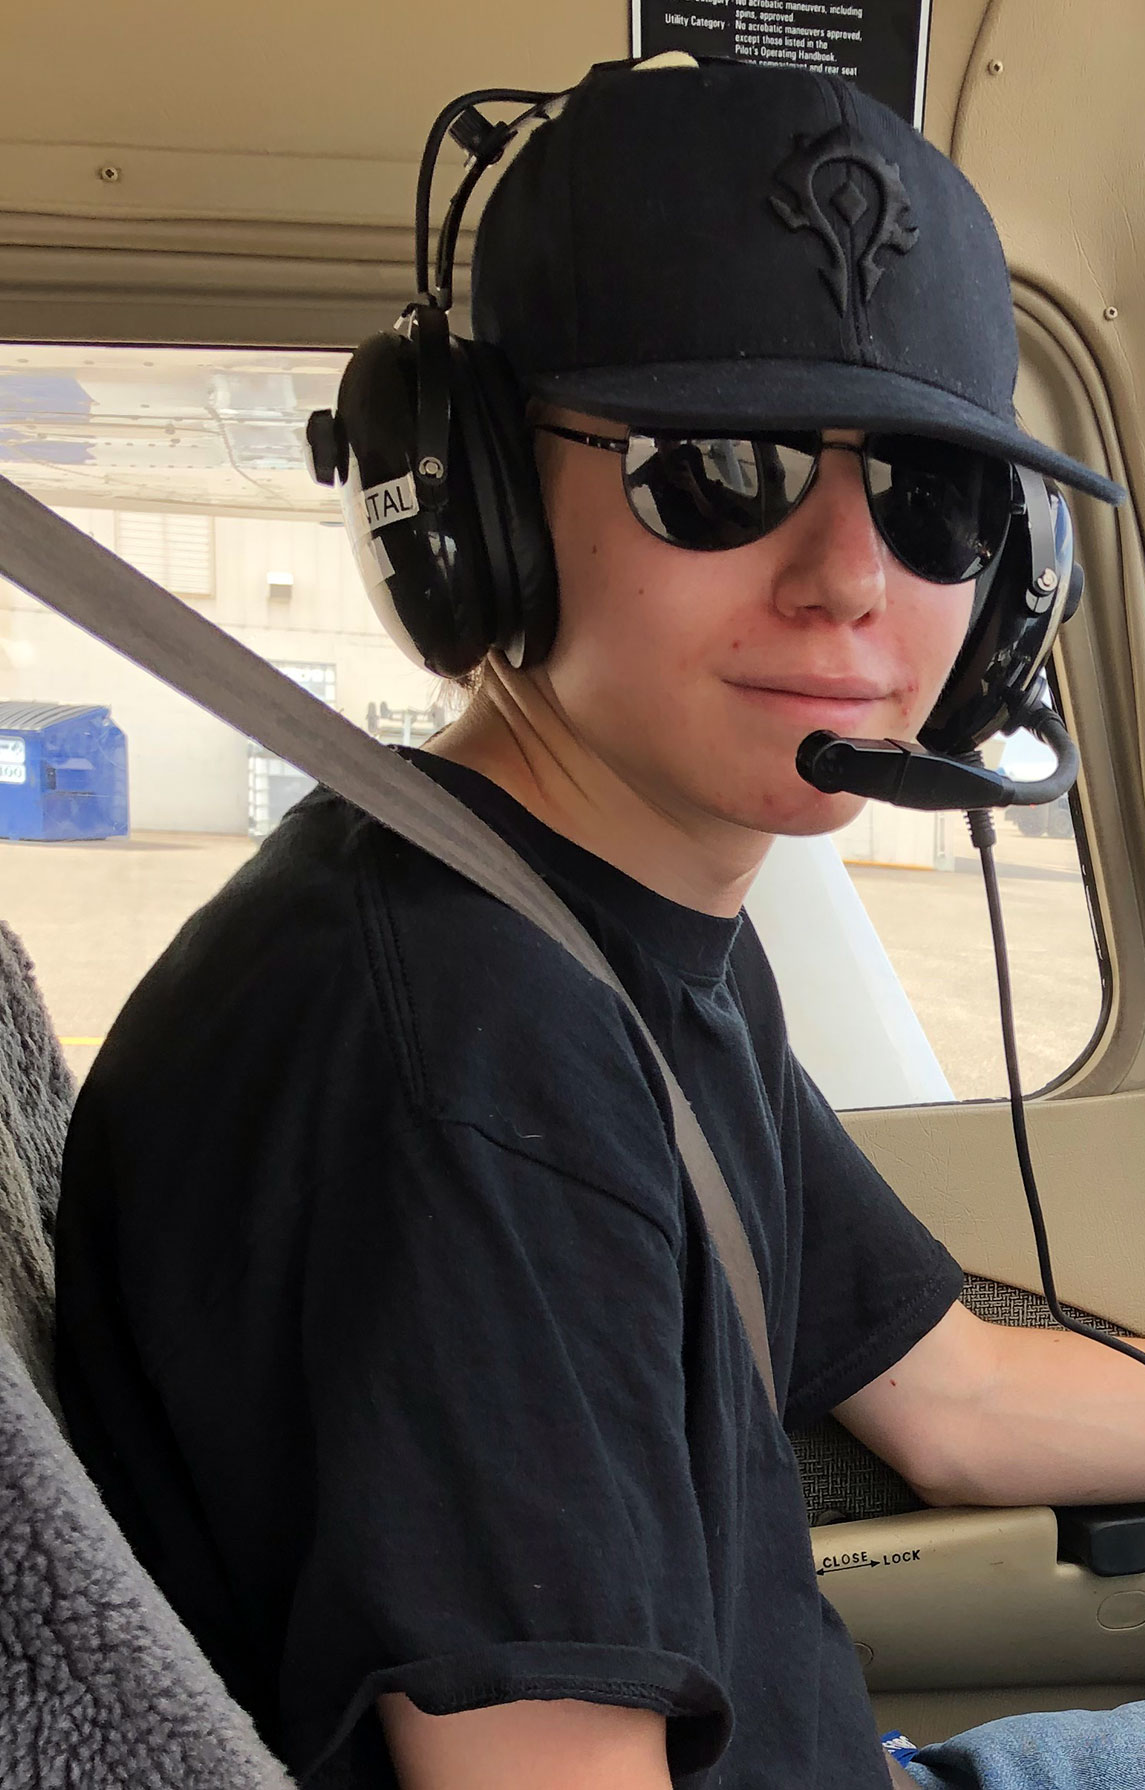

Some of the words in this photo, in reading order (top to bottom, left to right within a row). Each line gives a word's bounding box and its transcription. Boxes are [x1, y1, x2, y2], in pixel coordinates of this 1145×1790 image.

[748, 0, 783, 9] acrobatic
[829, 7, 863, 19] including
[759, 11, 794, 23] approved
[665, 13, 689, 27] Utility
[690, 15, 726, 31] Category
[735, 20, 746, 31] No
[748, 22, 783, 35] acrobatic
[784, 26, 825, 38] maneuvers
[826, 29, 863, 42] approved,
[735, 34, 760, 45] except
[762, 35, 783, 46] those
[784, 37, 806, 48] listed
[806, 39, 815, 49] in
[815, 40, 829, 50] the
[735, 44, 759, 56] Pilot's
[760, 47, 797, 61] Operating
[798, 50, 838, 62] Handbook.
[809, 63, 823, 74] and
[824, 65, 840, 75] rear
[841, 66, 858, 76] seat
[366, 486, 412, 524] TAL
[822, 1551, 868, 1568] CLOSE
[883, 1549, 920, 1565] LOCK
